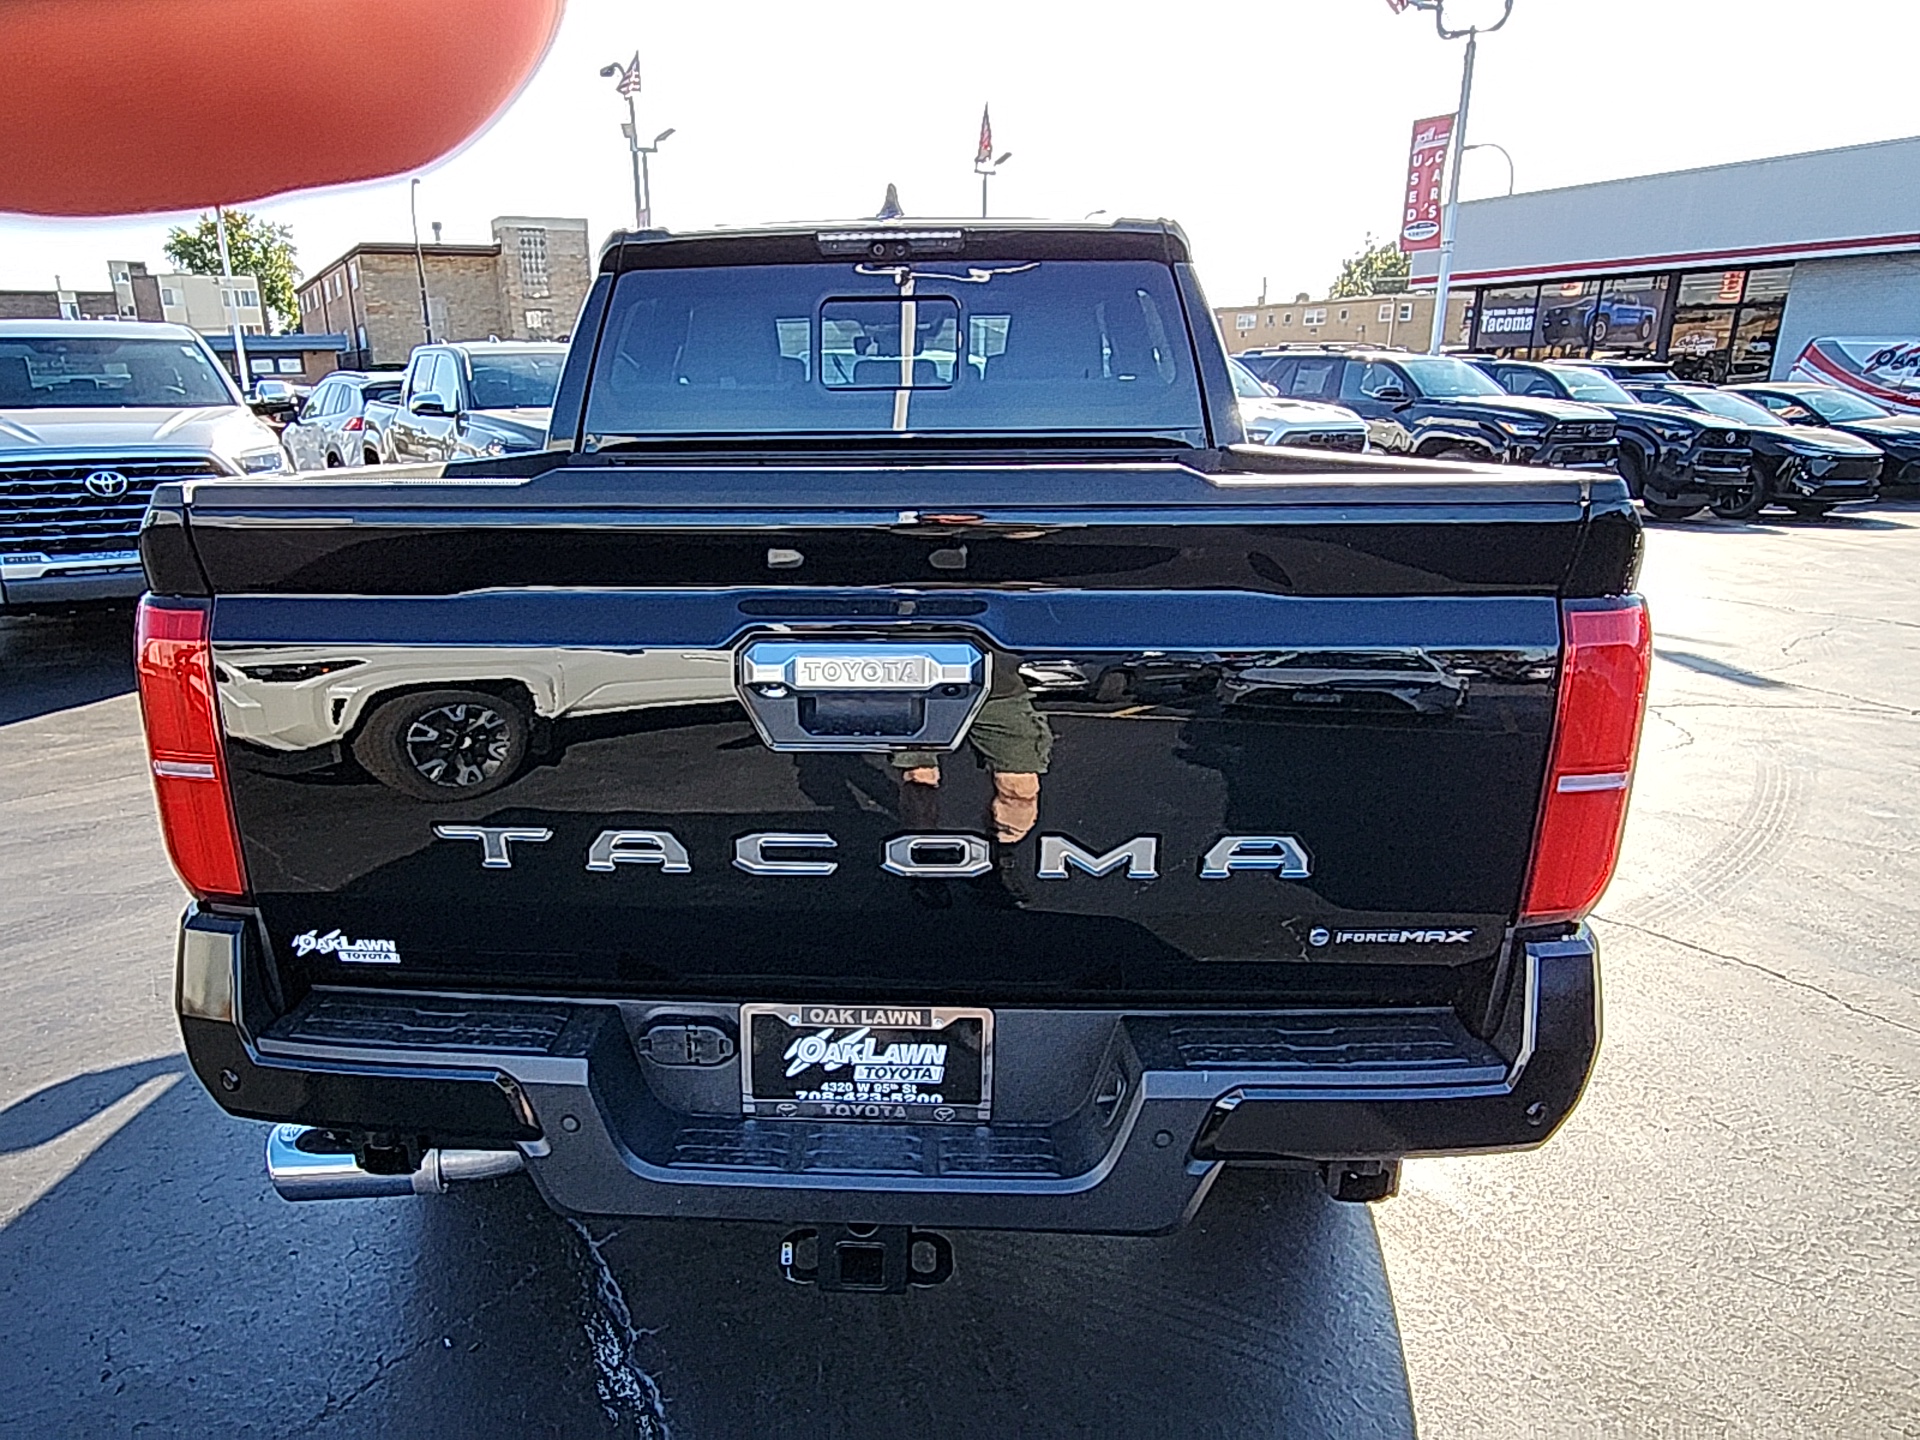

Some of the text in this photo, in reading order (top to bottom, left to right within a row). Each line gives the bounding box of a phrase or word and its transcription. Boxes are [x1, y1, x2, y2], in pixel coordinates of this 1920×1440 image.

[1406, 153, 1422, 221] USED
[1480, 315, 1534, 333] Tacoma
[804, 661, 919, 682] TOYOTA
[433, 824, 1312, 879] TACOMA
[345, 952, 392, 960] TOYOTA
[809, 1008, 922, 1026] OAK LAWN
[863, 1066, 934, 1080] TOYOTA
[820, 1082, 918, 1094] 4320 W 95th St
[820, 1103, 907, 1118] TOYOTA
